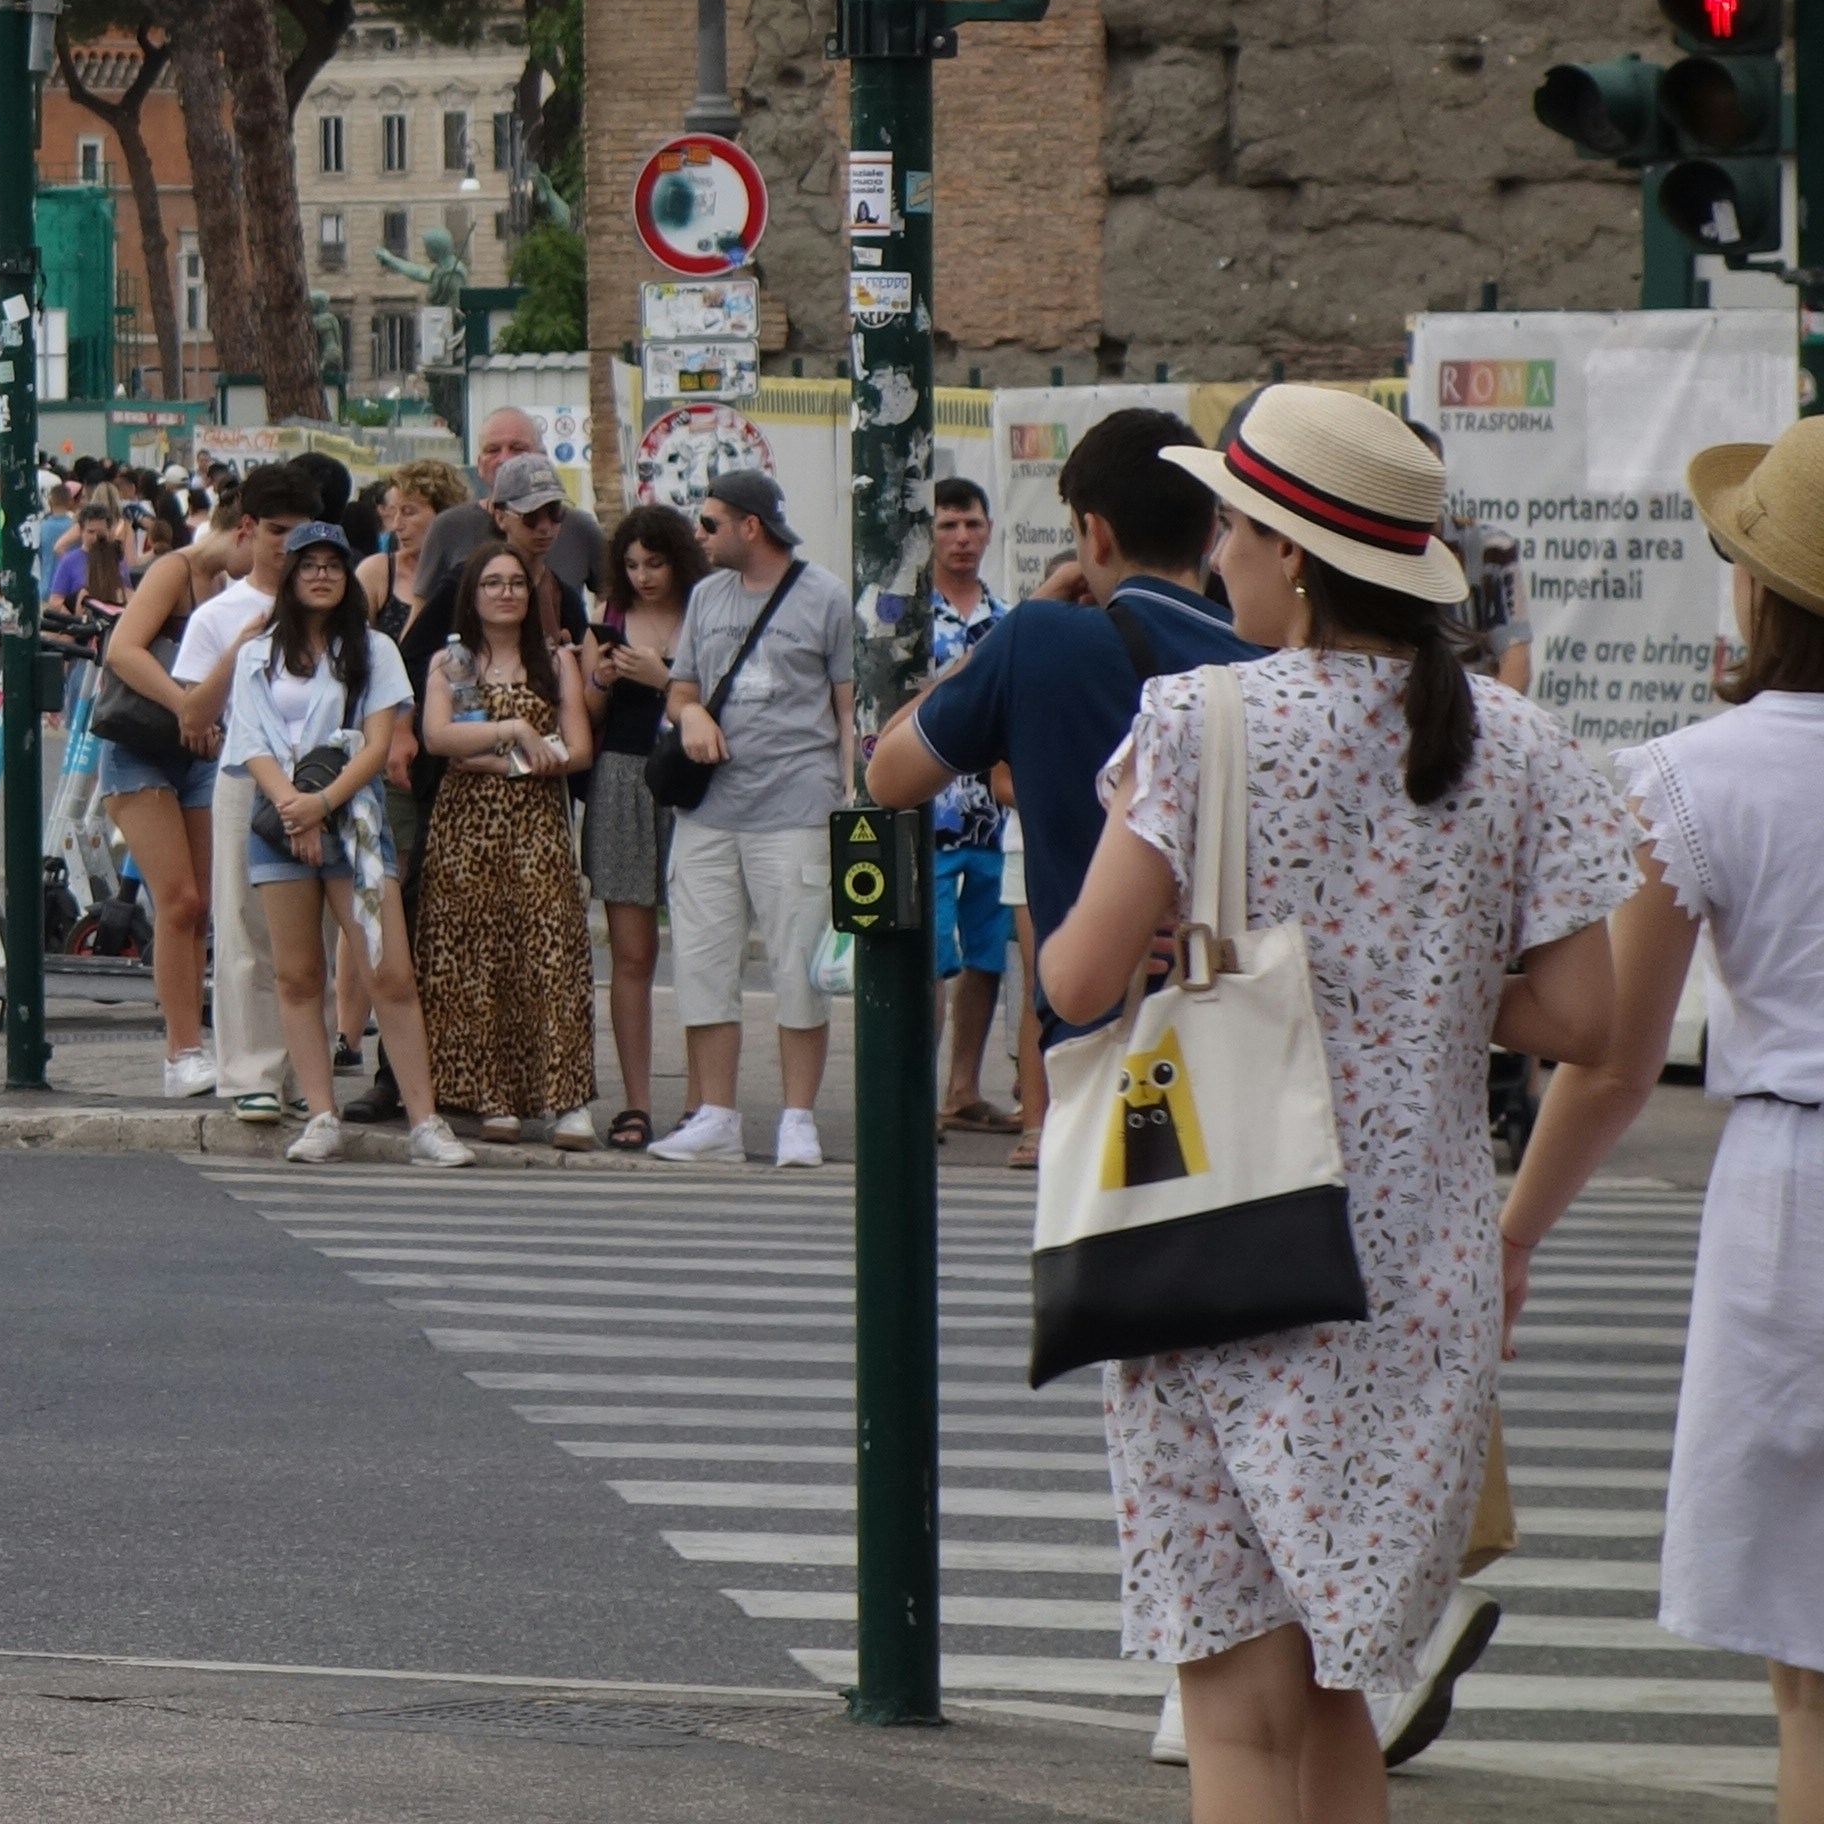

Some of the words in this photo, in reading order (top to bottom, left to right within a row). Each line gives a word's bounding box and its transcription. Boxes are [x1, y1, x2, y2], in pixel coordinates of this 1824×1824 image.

[1441, 366, 1551, 401] ROMA
[1455, 413, 1554, 431] TRASFORMA
[1528, 492, 1639, 526] portando
[1649, 492, 1694, 520] alla
[1544, 538, 1619, 560] nuova
[1627, 538, 1684, 560] area
[1531, 569, 1643, 606] Imperiali
[1545, 635, 1588, 661] We
[1595, 643, 1636, 662] are
[1538, 671, 1599, 706] light
[1607, 681, 1622, 701] a
[1629, 682, 1684, 701] new
[1572, 710, 1679, 744] Imperial
